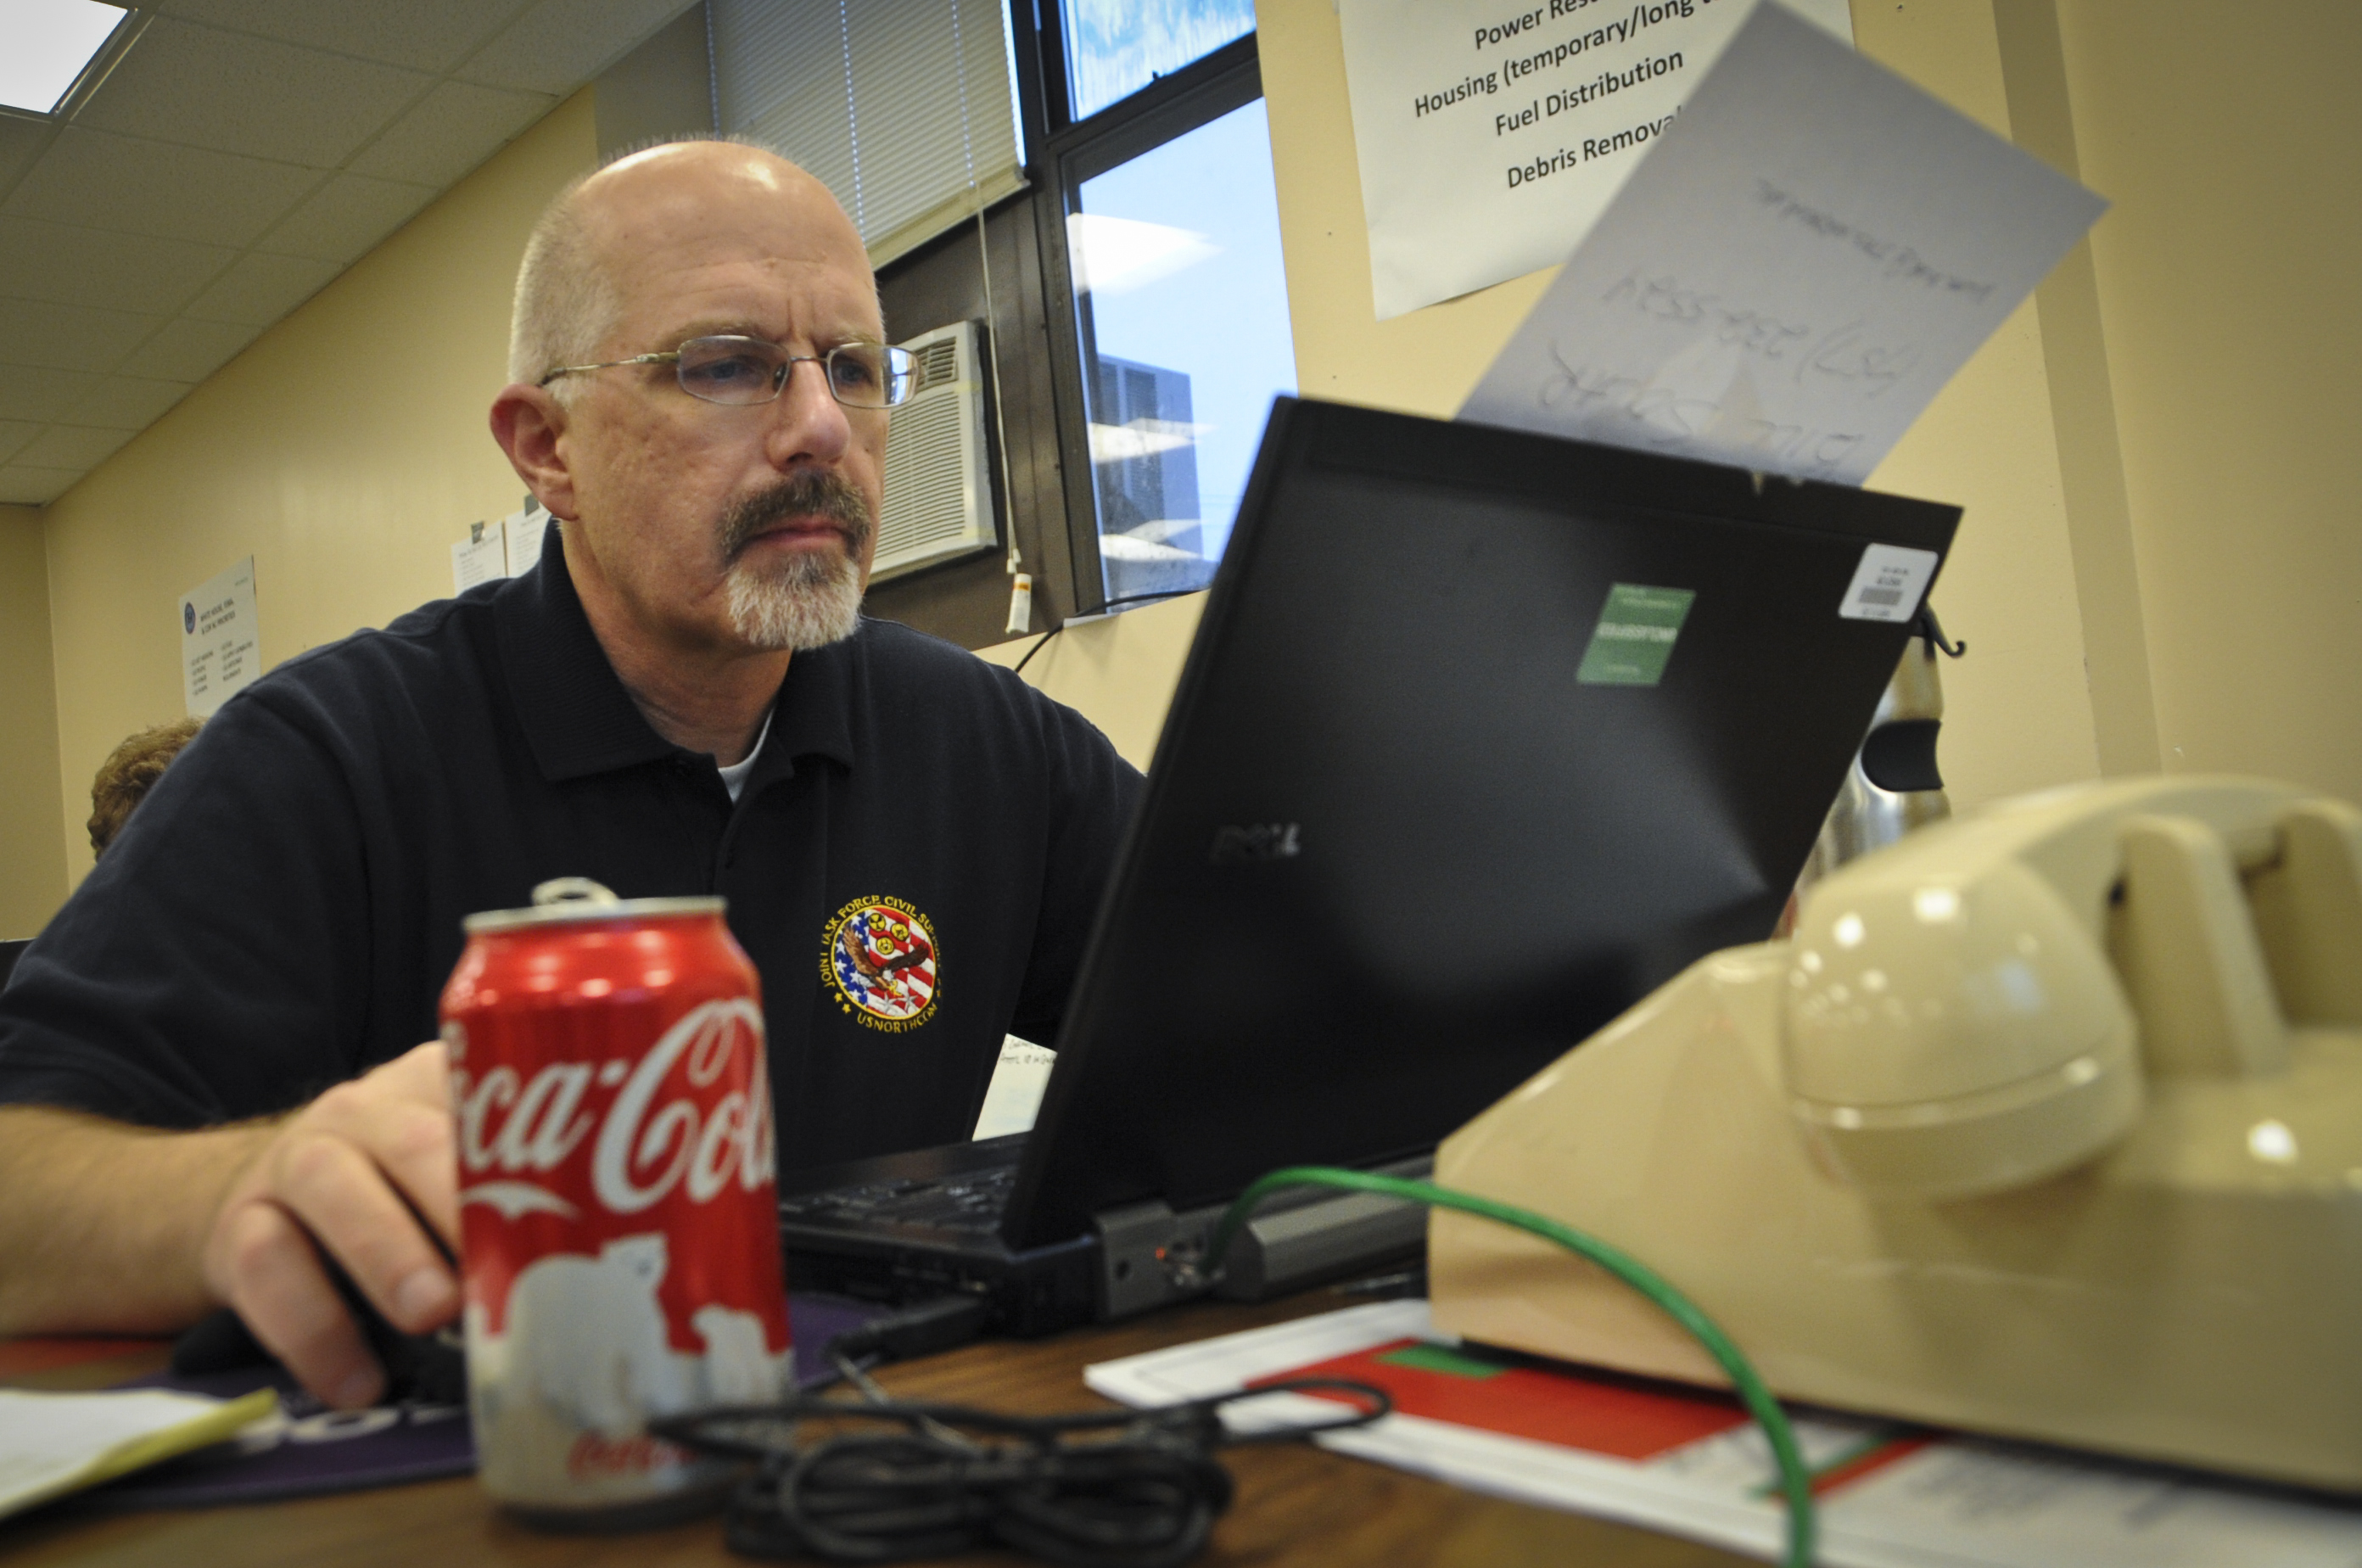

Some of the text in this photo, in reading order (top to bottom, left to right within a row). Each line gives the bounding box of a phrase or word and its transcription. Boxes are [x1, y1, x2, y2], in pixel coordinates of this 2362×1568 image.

[1475, 8, 1543, 50] Power
[1414, 0, 1695, 117] Housing (temporary/long
[1495, 52, 1683, 136] Fuel Distribution
[1508, 148, 1576, 188] Debris
[837, 894, 882, 918] FORCE
[884, 895, 917, 917] CIVIL
[821, 916, 841, 945] TASK
[820, 951, 836, 988] JOINT
